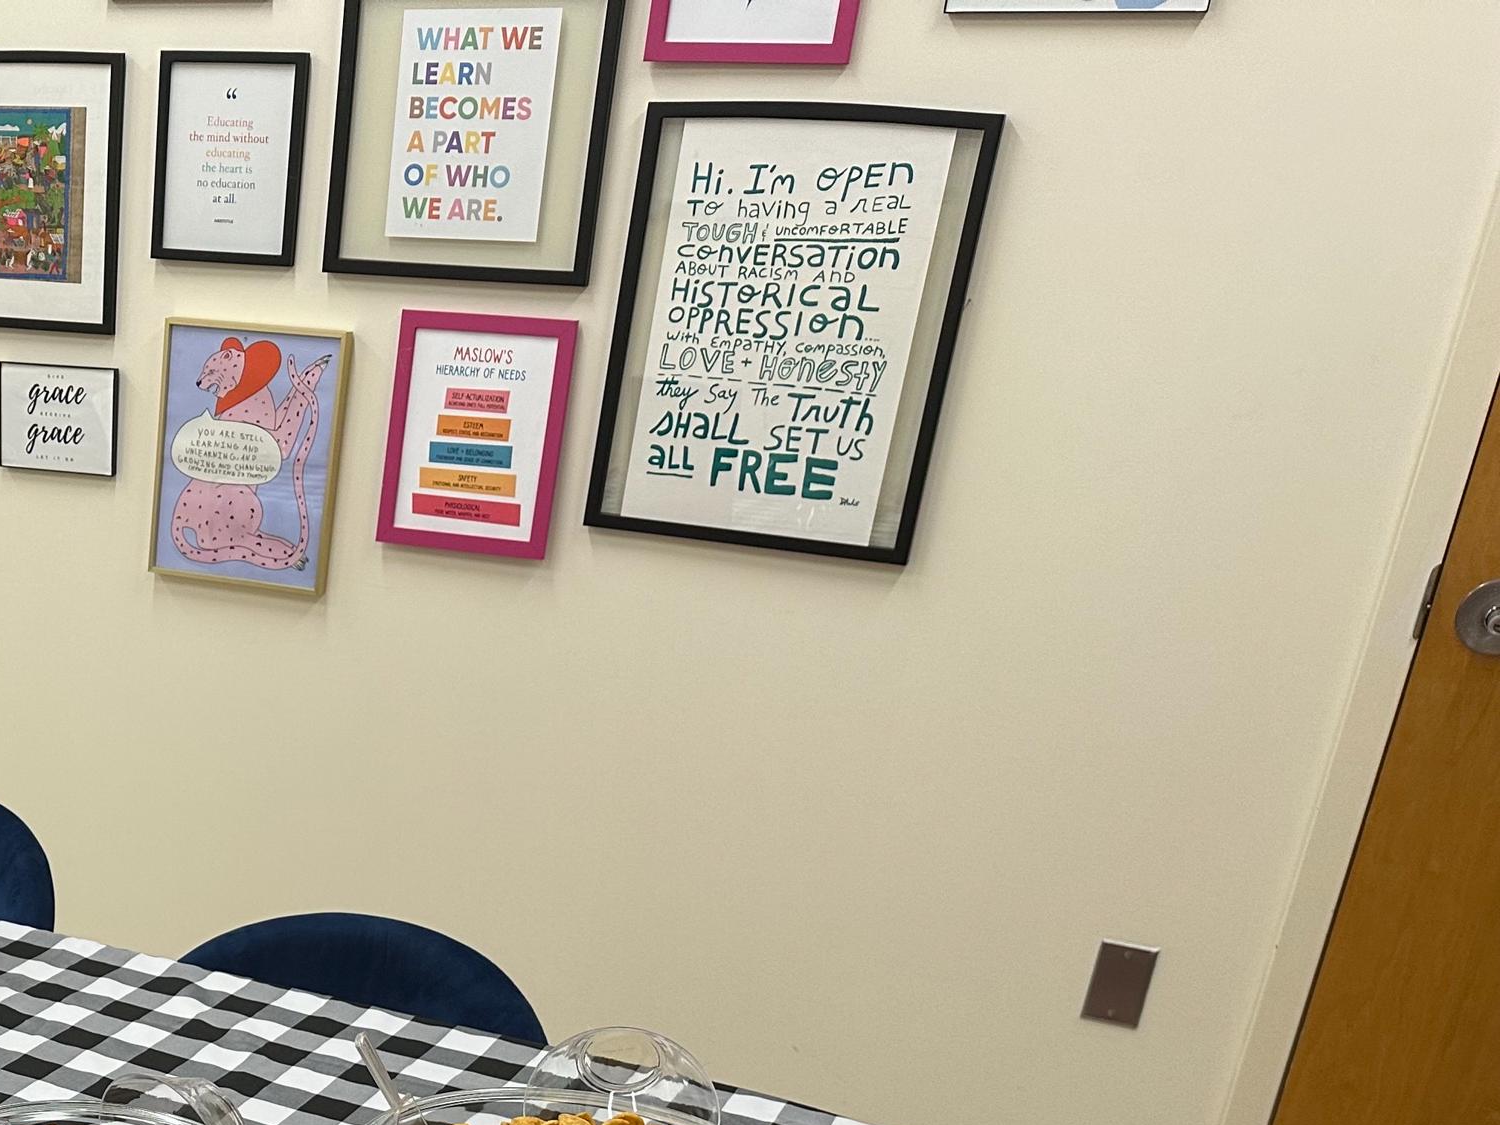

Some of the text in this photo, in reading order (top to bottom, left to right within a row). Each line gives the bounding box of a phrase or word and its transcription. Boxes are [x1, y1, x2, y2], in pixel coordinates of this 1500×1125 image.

[417, 27, 543, 50] WHAT WE
[412, 62, 492, 85] LEARN
[409, 96, 532, 120] BECOMES
[207, 116, 254, 129] Educating
[190, 131, 269, 144] the mind without
[407, 130, 496, 154] A PART
[206, 149, 250, 161] educating
[202, 163, 252, 174] the heart is
[404, 163, 510, 188] OF WHO
[691, 162, 733, 195] Hi.
[744, 164, 795, 195] I'm
[211, 179, 255, 189] education
[213, 194, 236, 204] at all.
[403, 197, 502, 221] WE ARE.
[738, 199, 811, 227] having
[825, 200, 837, 215] a
[682, 222, 758, 243] TOUGH
[454, 346, 513, 364] MASLOW'S
[660, 343, 735, 374] LOVE
[436, 364, 526, 381] HIERARCHY OF NEEDS
[27, 384, 87, 414] grace
[656, 375, 700, 410] they
[752, 388, 780, 406] The
[26, 424, 85, 454] grace
[191, 440, 259, 453] LEARNING AND
[198, 428, 264, 443] YOU ARE STILL
[764, 425, 830, 454] SET
[837, 436, 866, 460] US
[178, 456, 216, 468] GROWING
[710, 447, 838, 500] FREE
